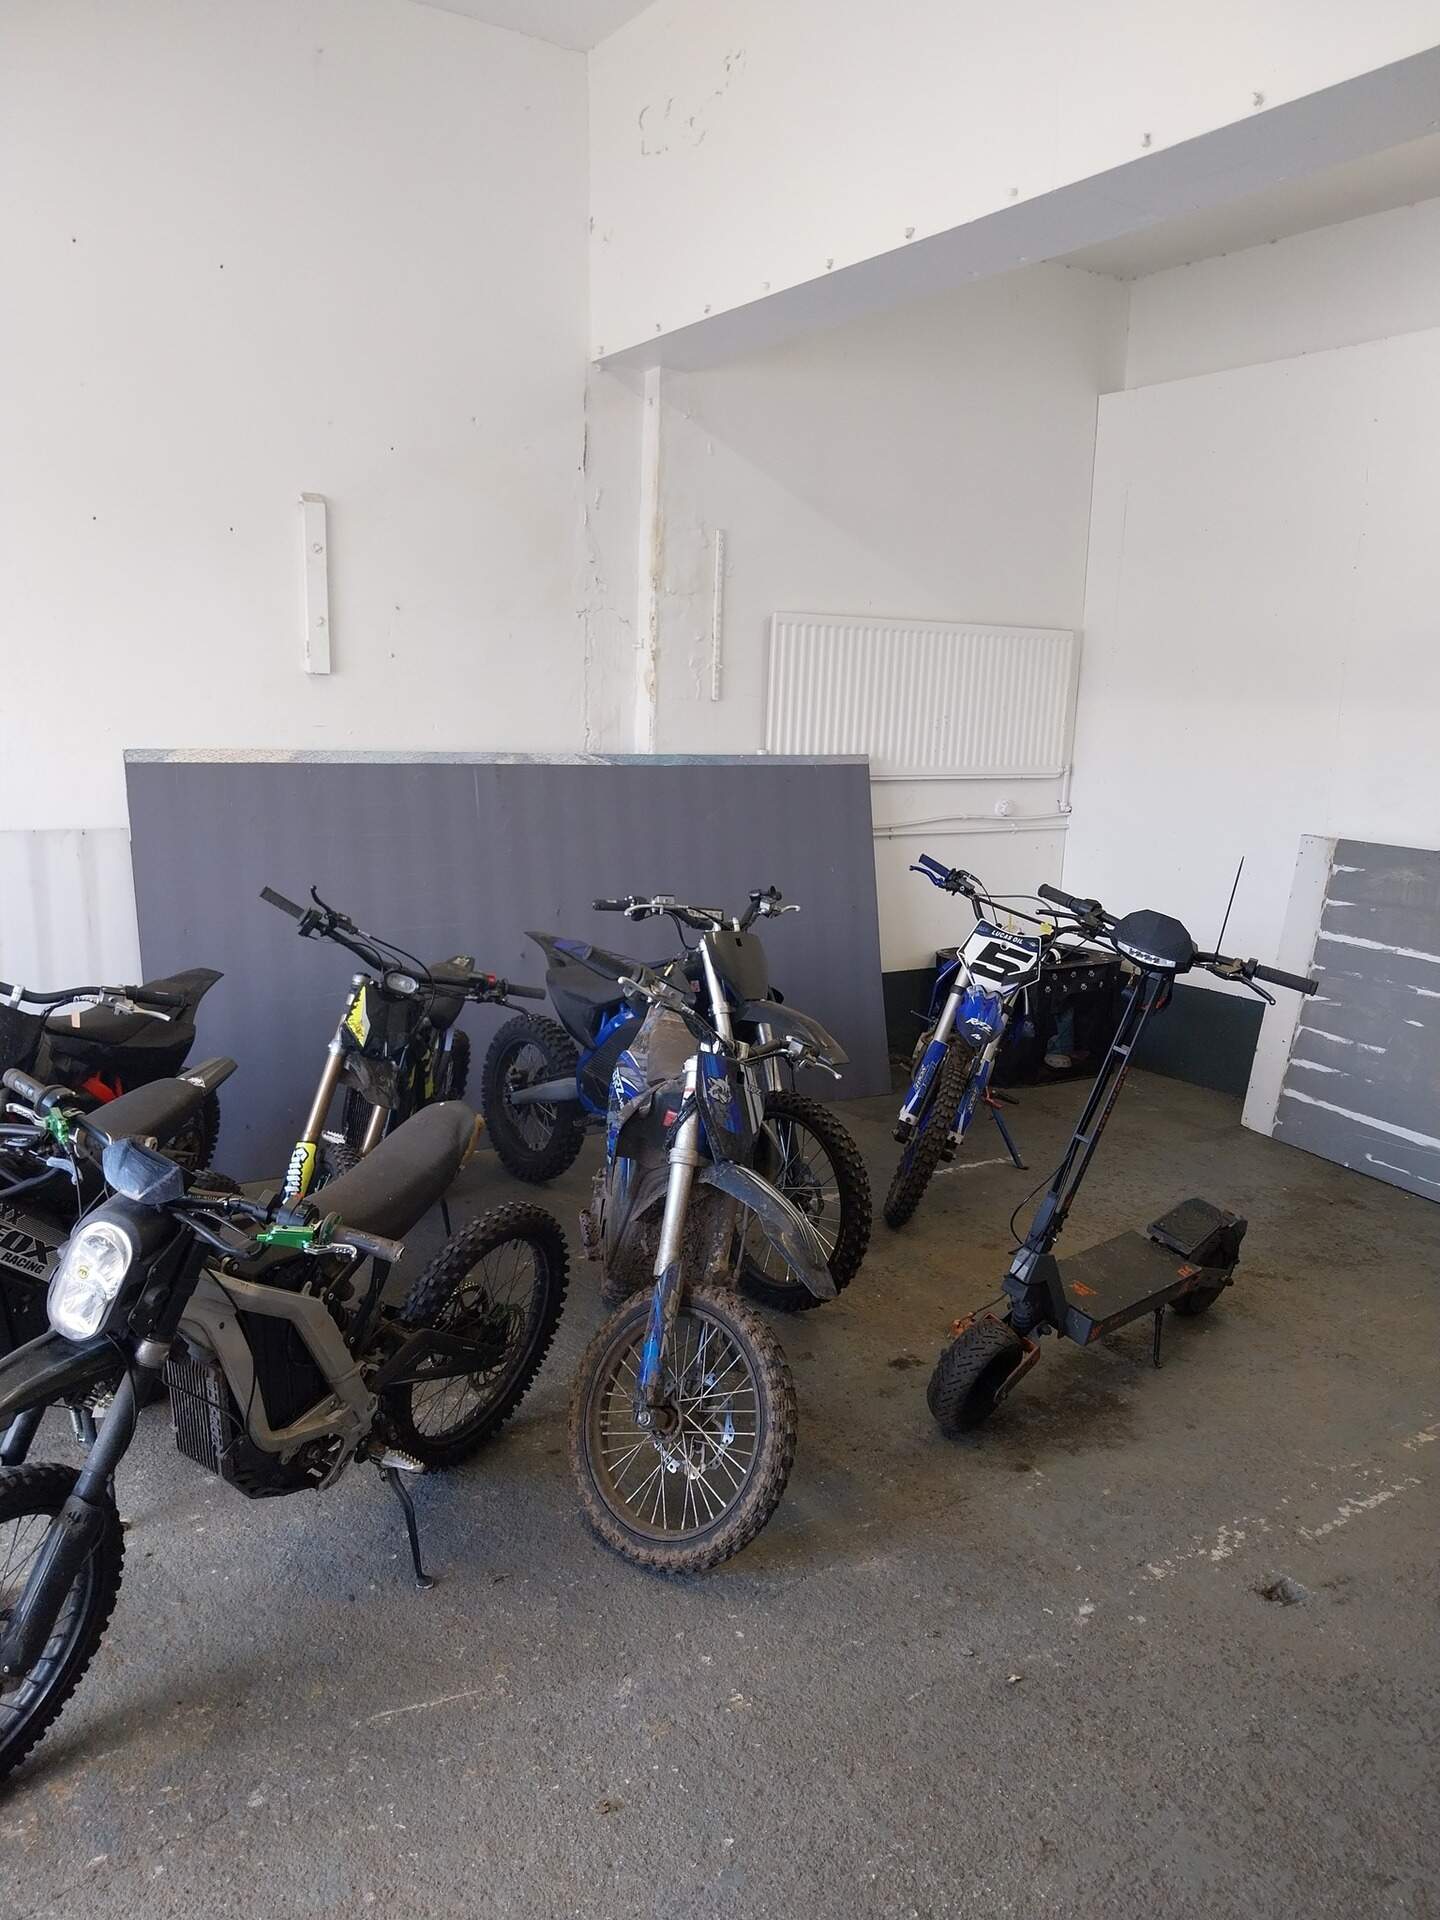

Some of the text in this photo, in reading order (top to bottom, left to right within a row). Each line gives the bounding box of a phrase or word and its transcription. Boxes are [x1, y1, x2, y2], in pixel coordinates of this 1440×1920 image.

[991, 929, 1024, 945] LUCAS OIL
[968, 940, 1034, 987] 5
[1, 1251, 46, 1274] RACING
